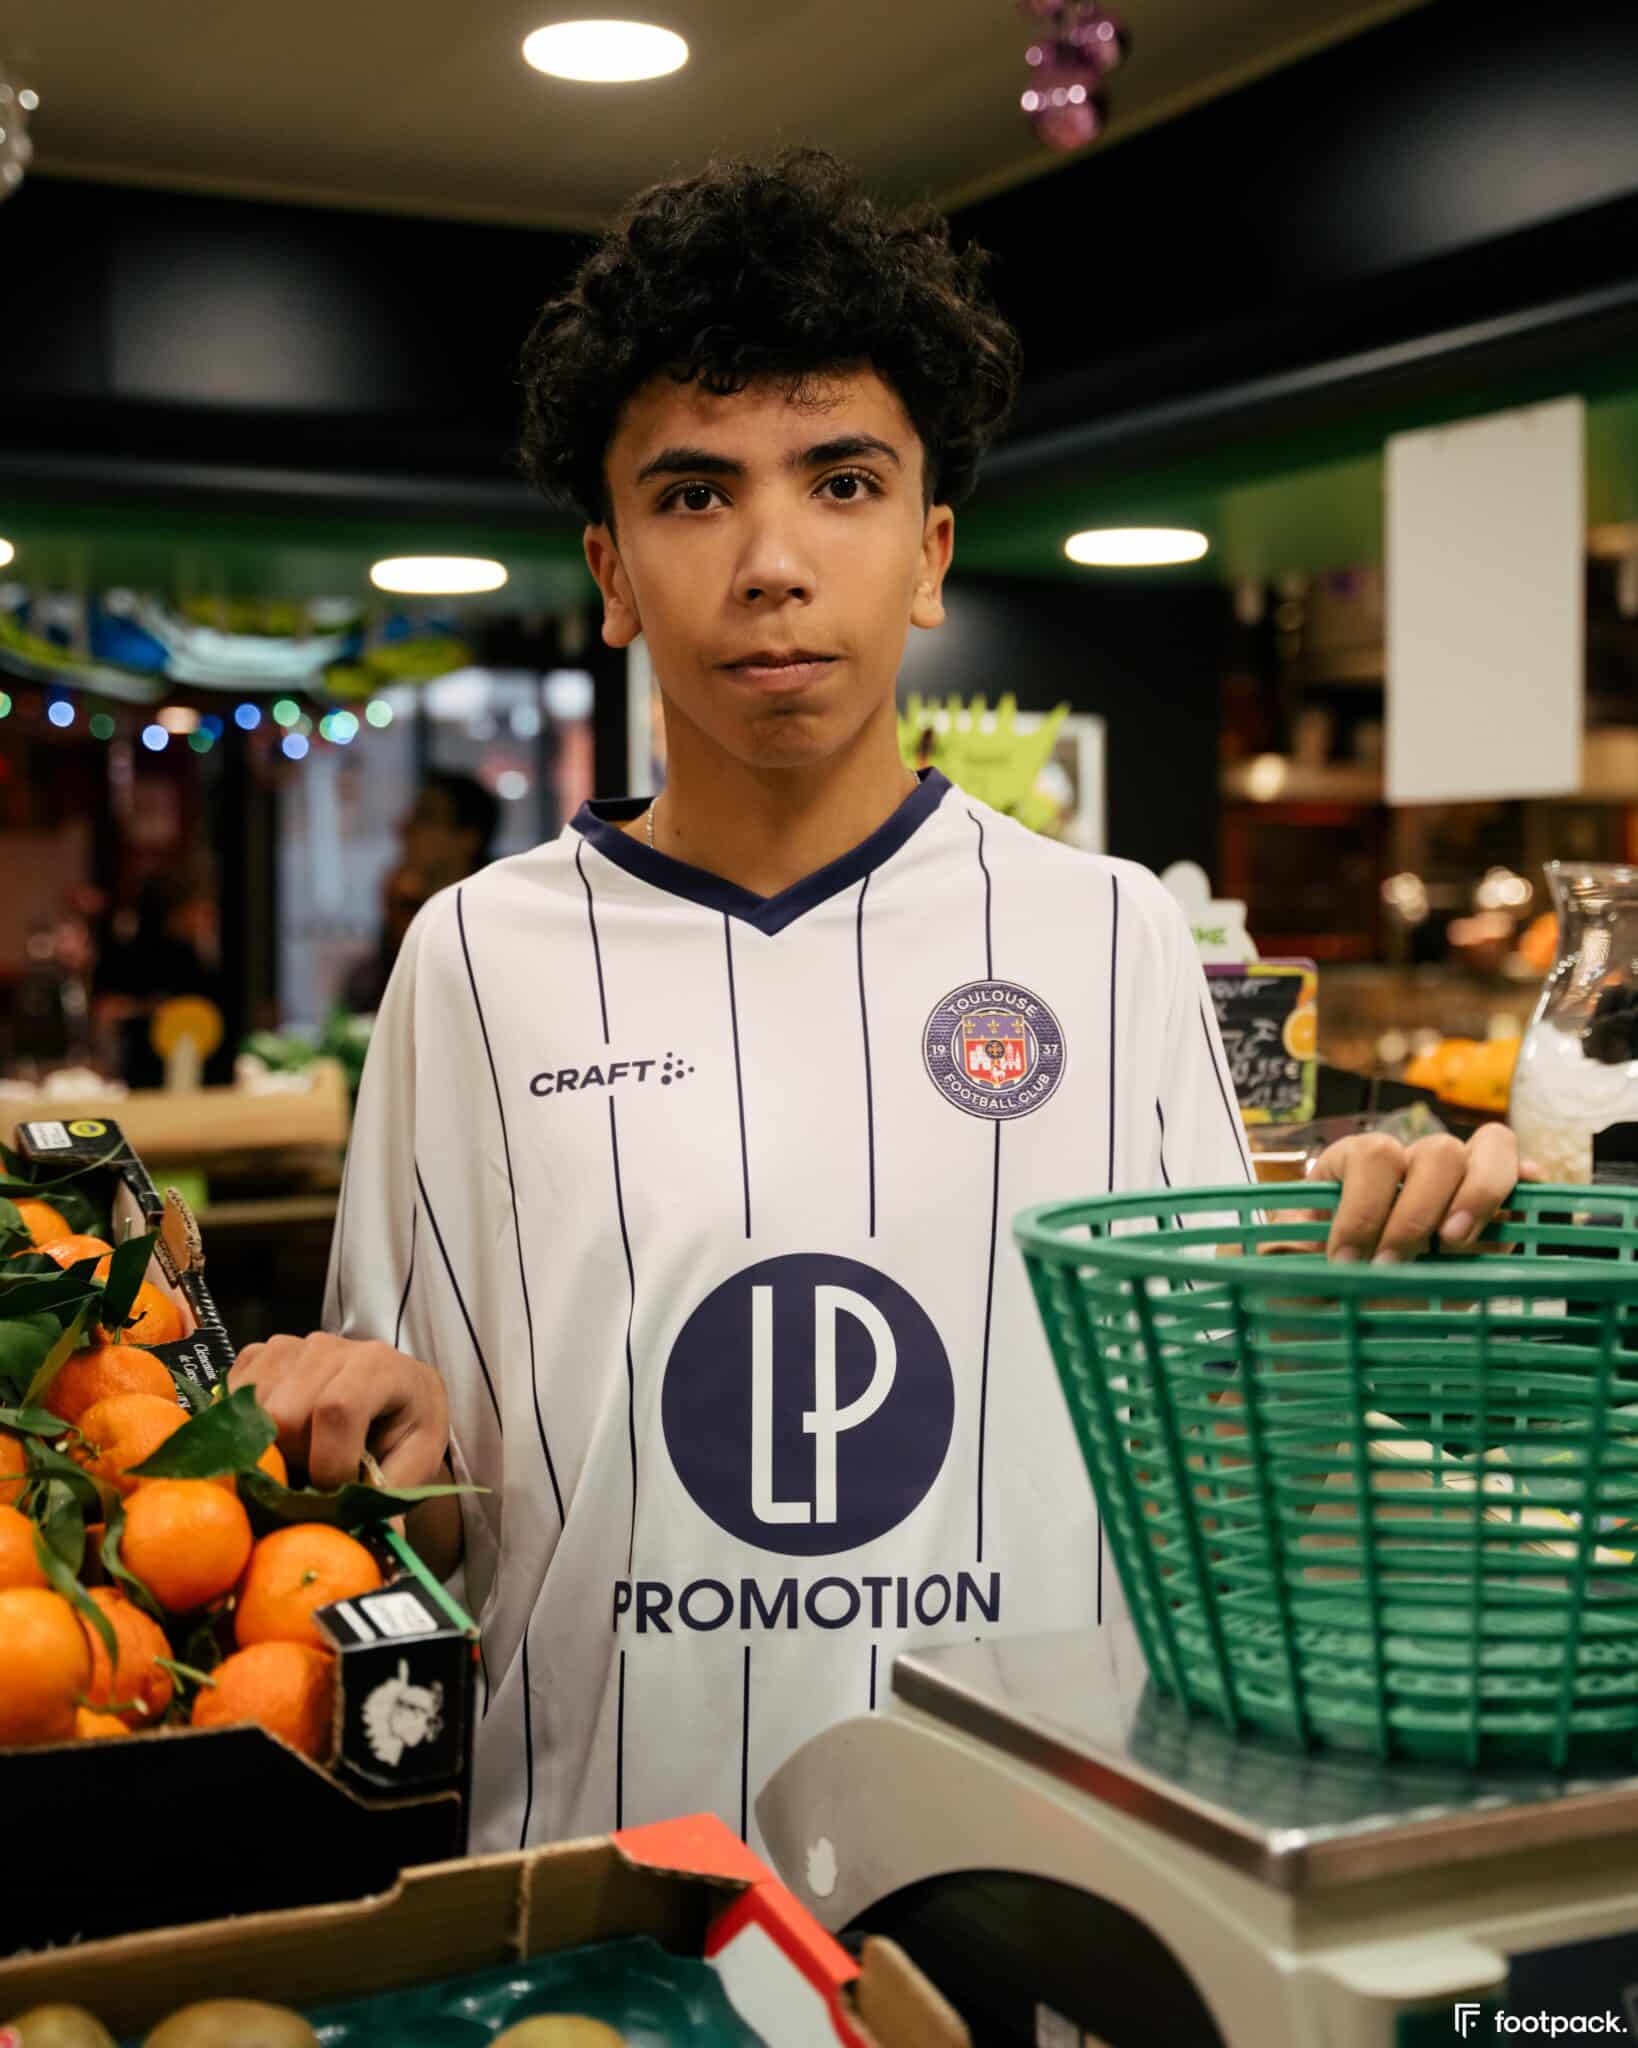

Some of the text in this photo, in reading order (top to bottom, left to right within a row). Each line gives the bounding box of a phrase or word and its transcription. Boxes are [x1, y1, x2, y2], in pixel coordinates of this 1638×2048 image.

[947, 990, 1038, 1018] TOULOUSE
[930, 1044, 946, 1056] 19
[1042, 1043, 1058, 1056] 37
[529, 1060, 656, 1097] CRAFT
[944, 1073, 1050, 1109] FOOTBALL CLUB
[752, 1285, 897, 1524] LP
[613, 1572, 1001, 1634] PROMOTION
